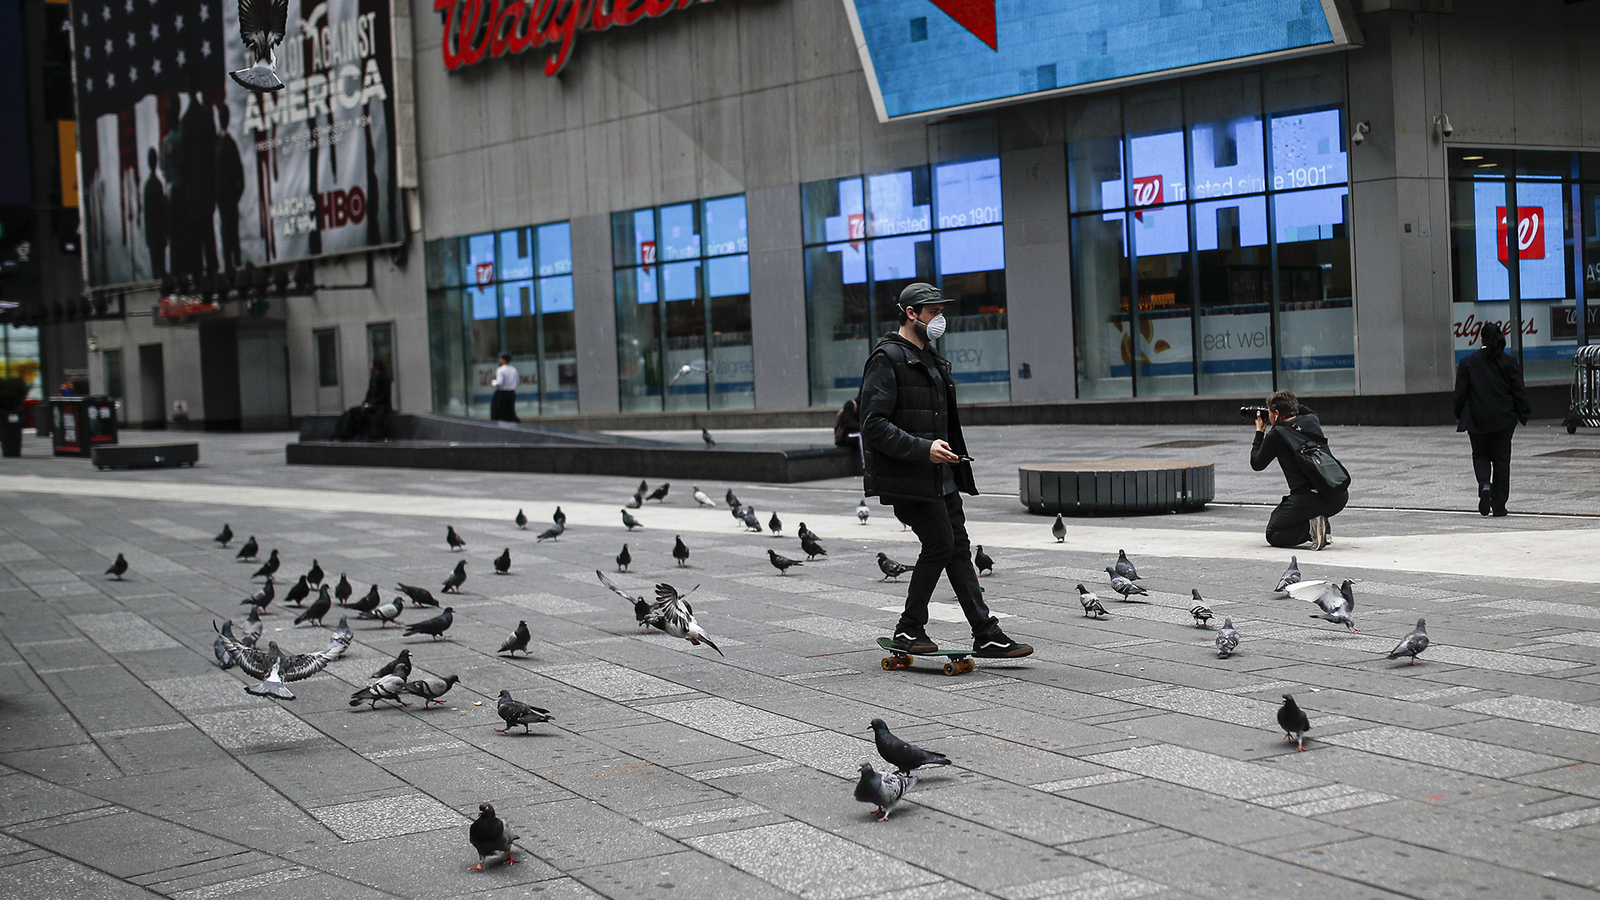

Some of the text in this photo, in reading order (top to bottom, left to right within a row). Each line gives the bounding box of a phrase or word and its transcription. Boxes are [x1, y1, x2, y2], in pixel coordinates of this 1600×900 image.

[312, 11, 376, 71] AGAINST
[243, 58, 388, 135] AMERICA
[1170, 176, 1233, 202] Trsted
[317, 185, 367, 231] HBO
[878, 214, 928, 237] Trusted
[1203, 329, 1232, 351] eat
